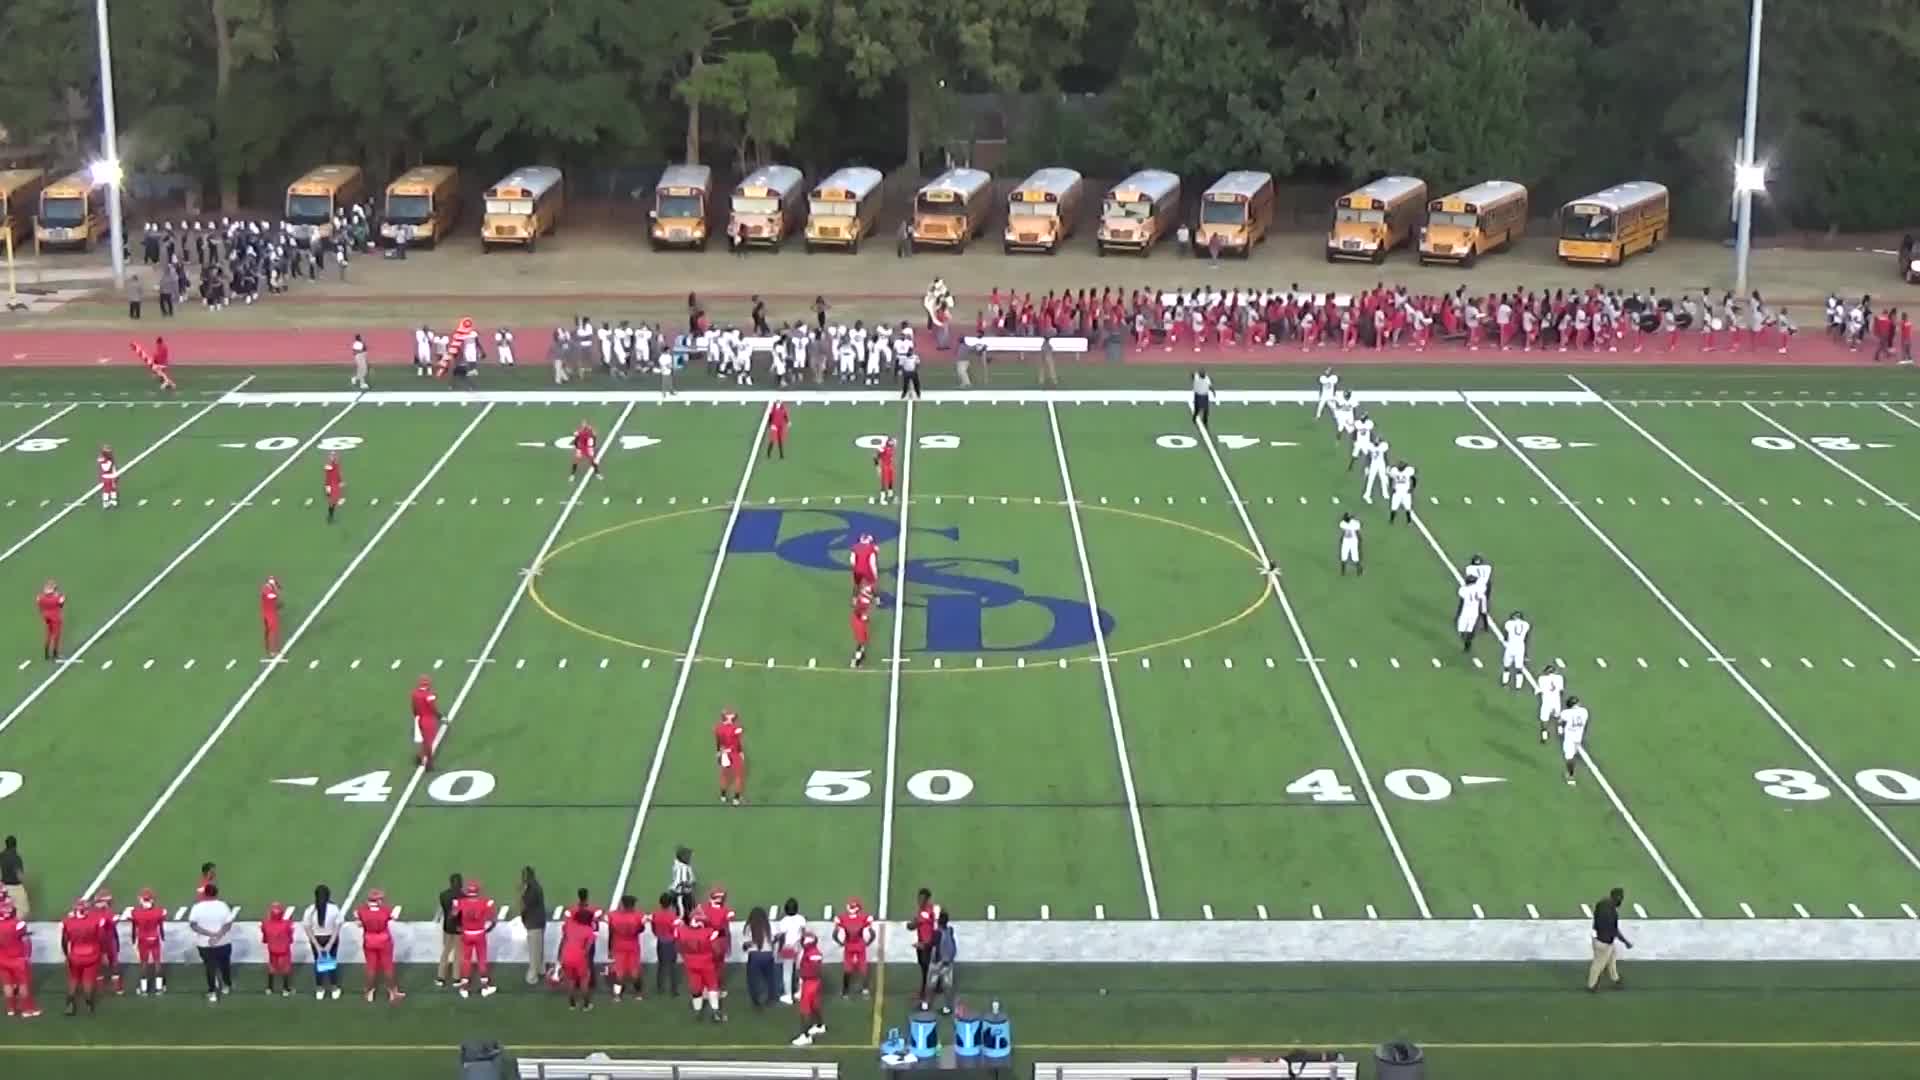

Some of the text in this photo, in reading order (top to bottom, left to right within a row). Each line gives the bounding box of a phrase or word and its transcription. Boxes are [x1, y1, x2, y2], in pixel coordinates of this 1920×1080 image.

[324, 769, 496, 804] 40
[804, 769, 974, 804] 50
[1285, 768, 1452, 803] 40
[1754, 768, 1920, 803] 30
